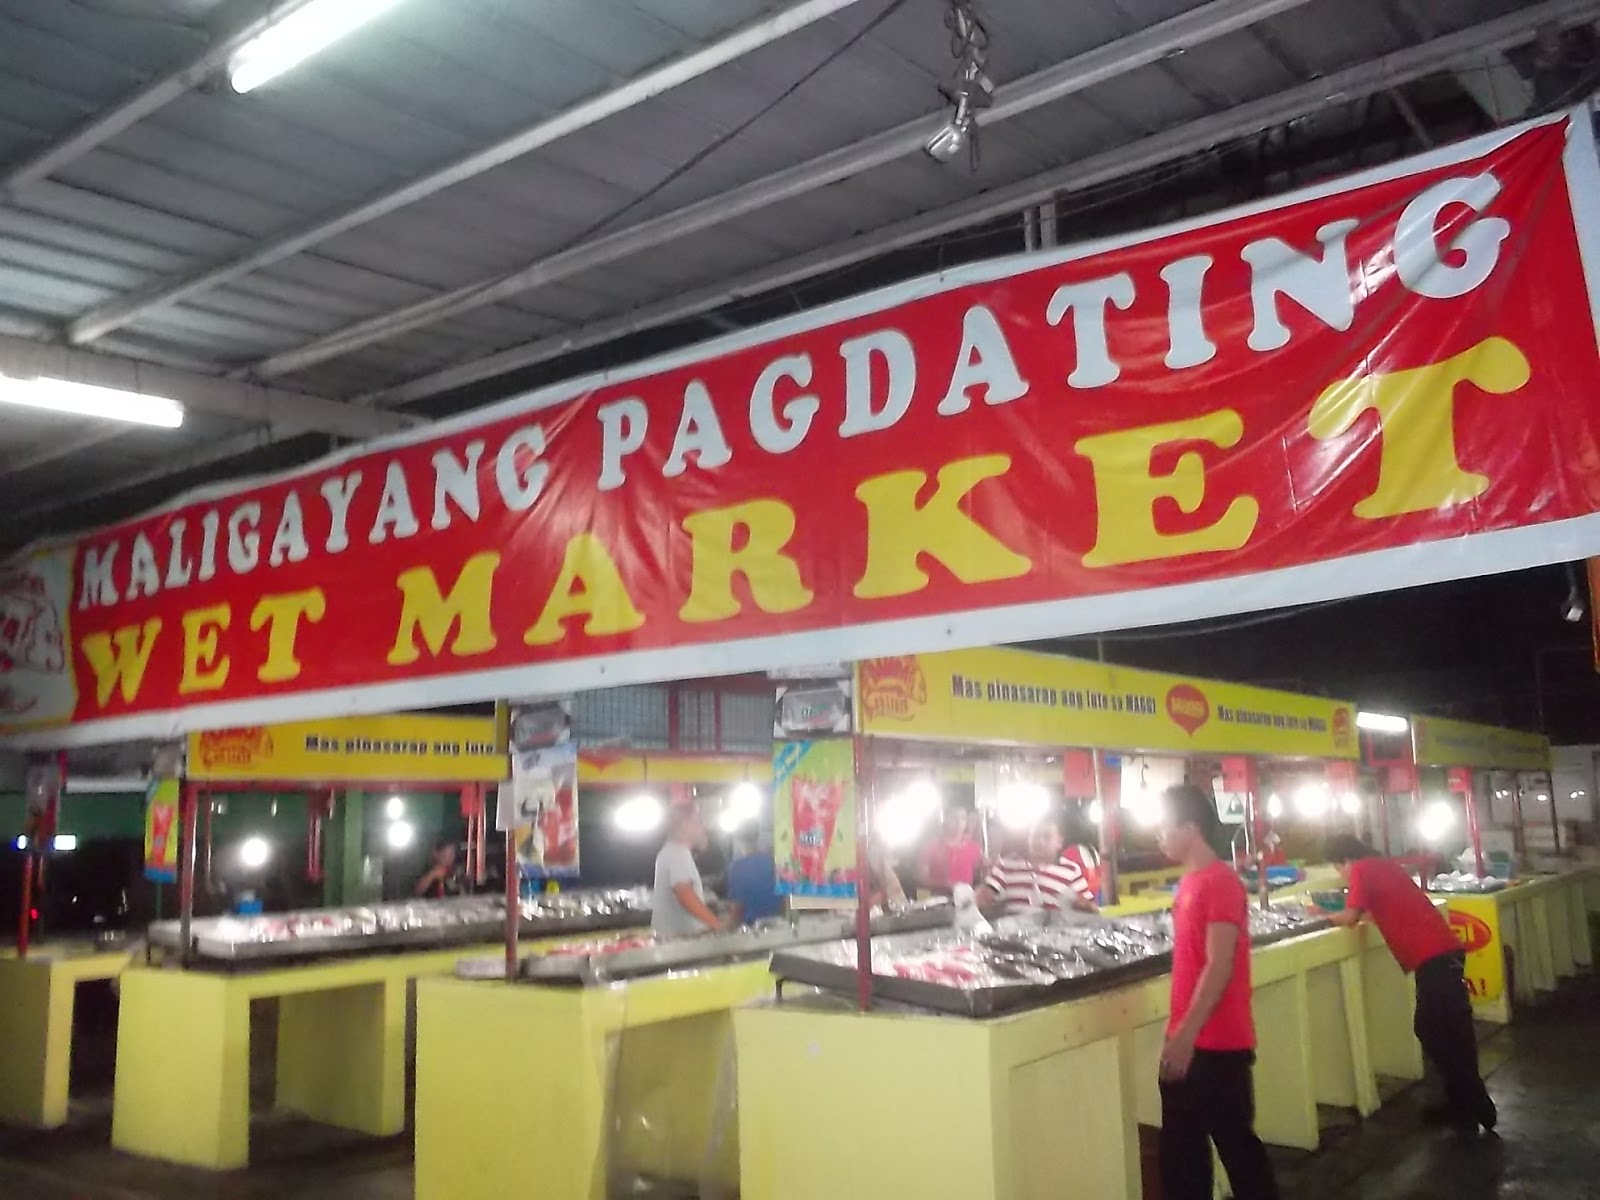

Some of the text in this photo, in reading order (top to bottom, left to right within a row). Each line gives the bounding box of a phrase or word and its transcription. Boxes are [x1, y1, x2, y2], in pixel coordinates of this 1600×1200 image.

[79, 170, 1512, 612] MALIGAYANG PAGDATING
[82, 335, 1532, 706] WET MARKET
[305, 736, 340, 752] Mas
[952, 673, 982, 698] Mas
